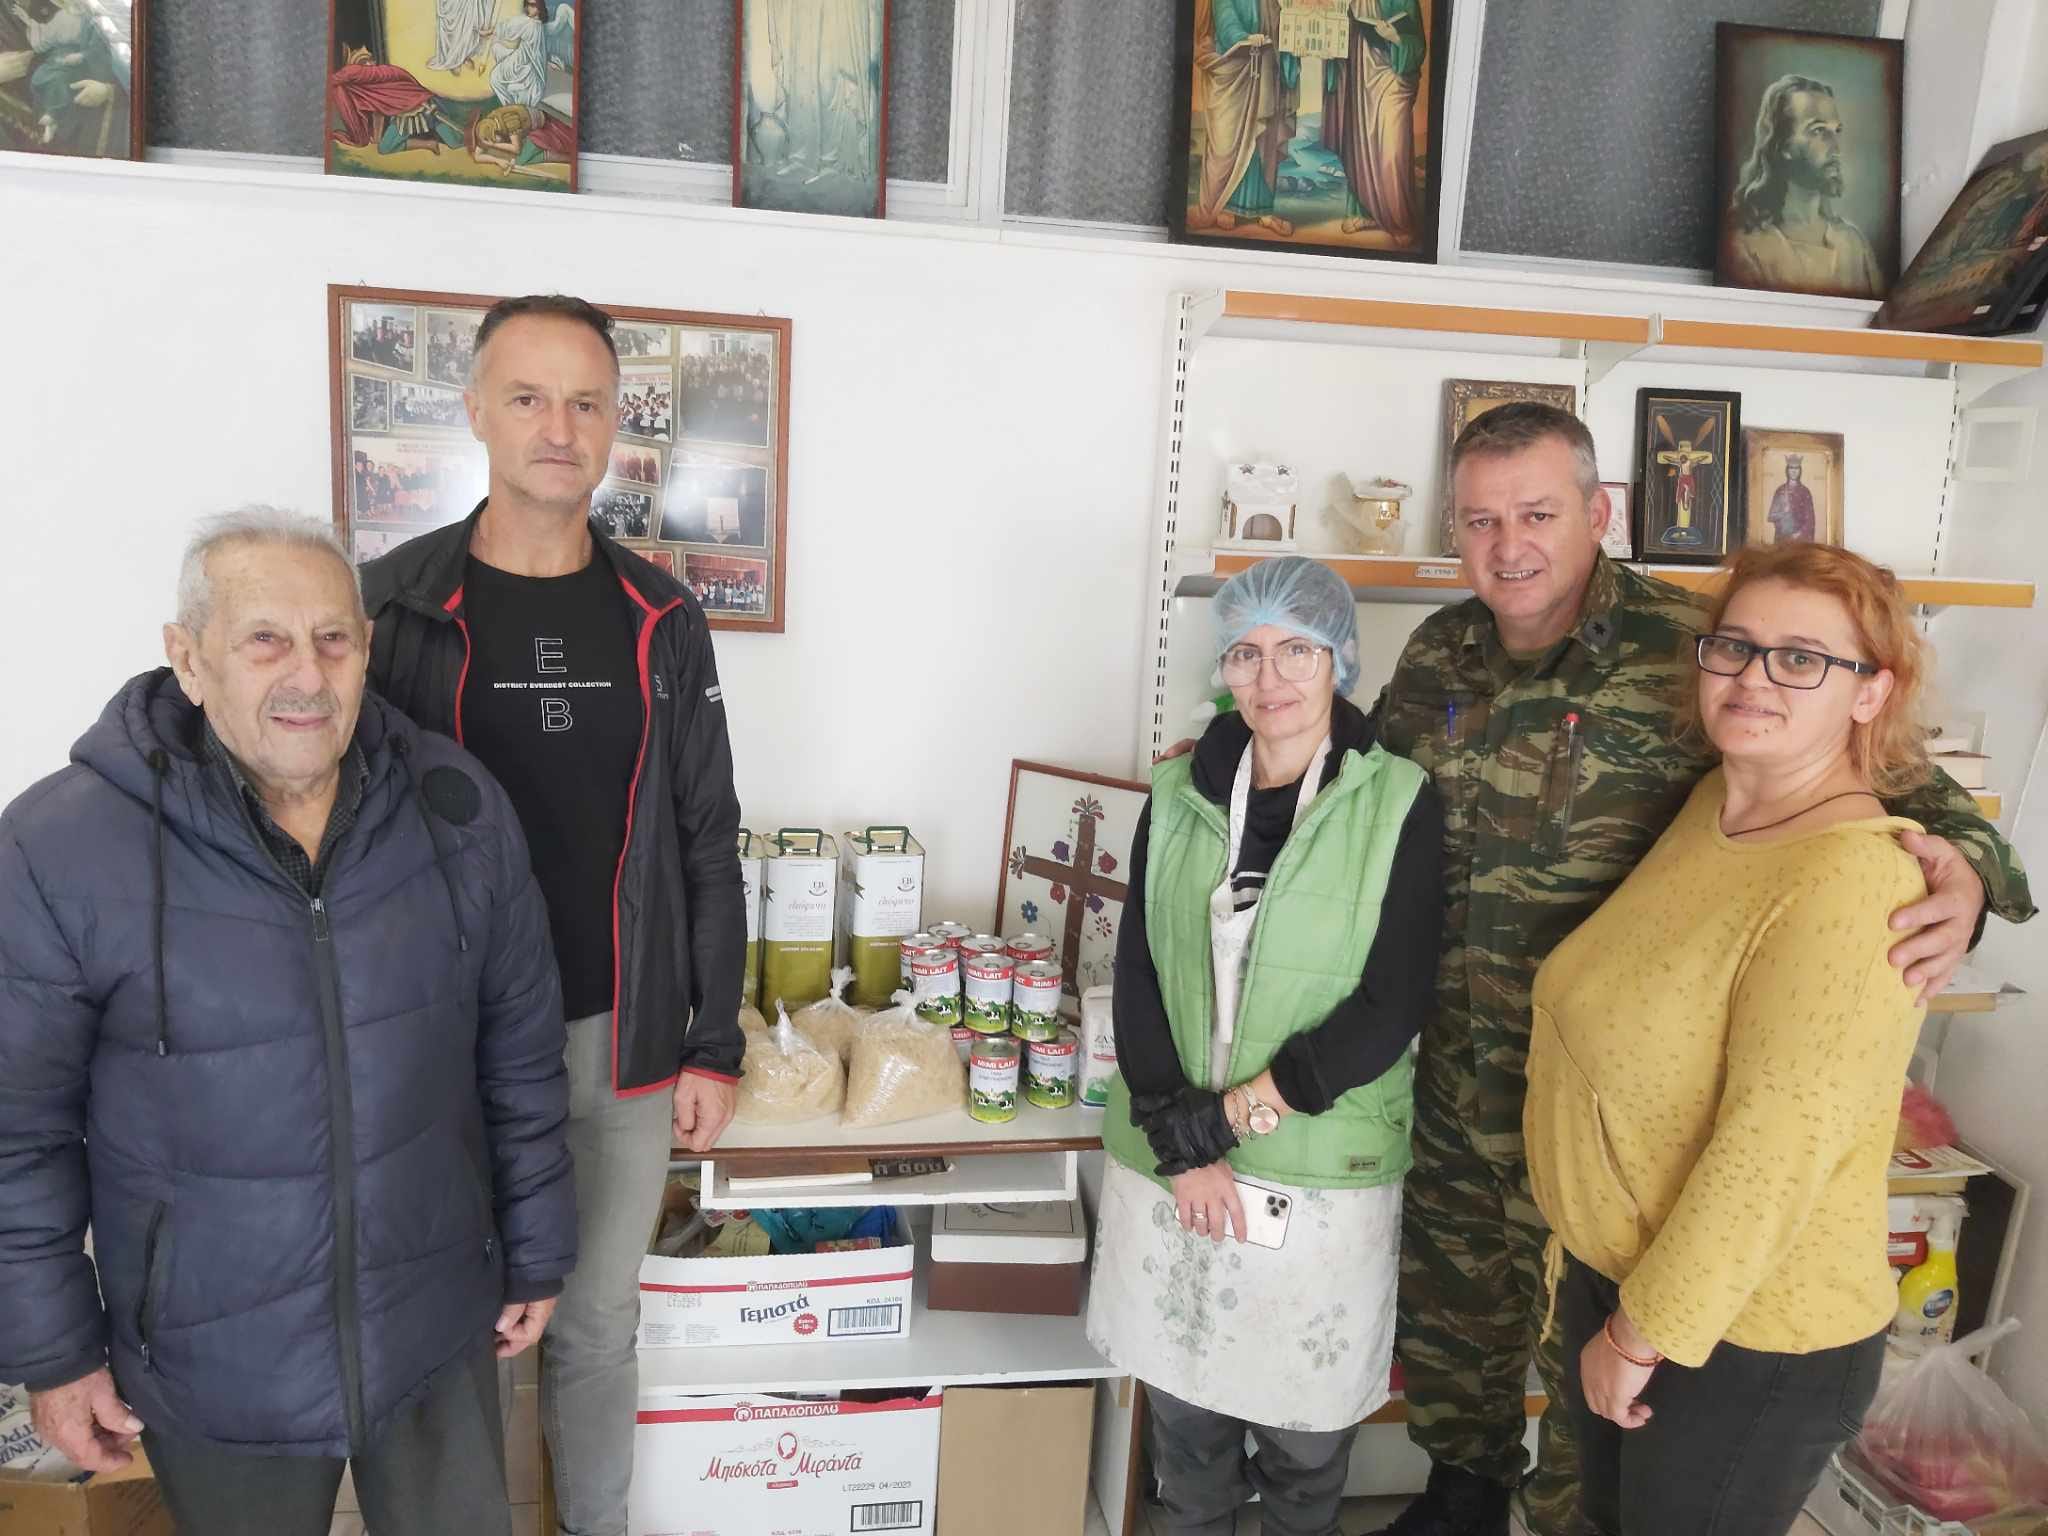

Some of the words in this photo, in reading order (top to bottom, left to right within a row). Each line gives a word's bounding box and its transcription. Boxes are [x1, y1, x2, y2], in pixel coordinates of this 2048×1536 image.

[535, 637, 567, 674] E
[541, 698, 573, 732] B
[929, 966, 948, 975] LAIT
[984, 971, 1003, 980] LAIT
[1048, 1046, 1066, 1056] LAIT
[977, 1058, 997, 1069] MIMI
[998, 1060, 1015, 1069] LAIT
[740, 1294, 810, 1323] Γεμιστά
[700, 1456, 777, 1482] Μπισκότα
[791, 1452, 863, 1478] Μιράντα
